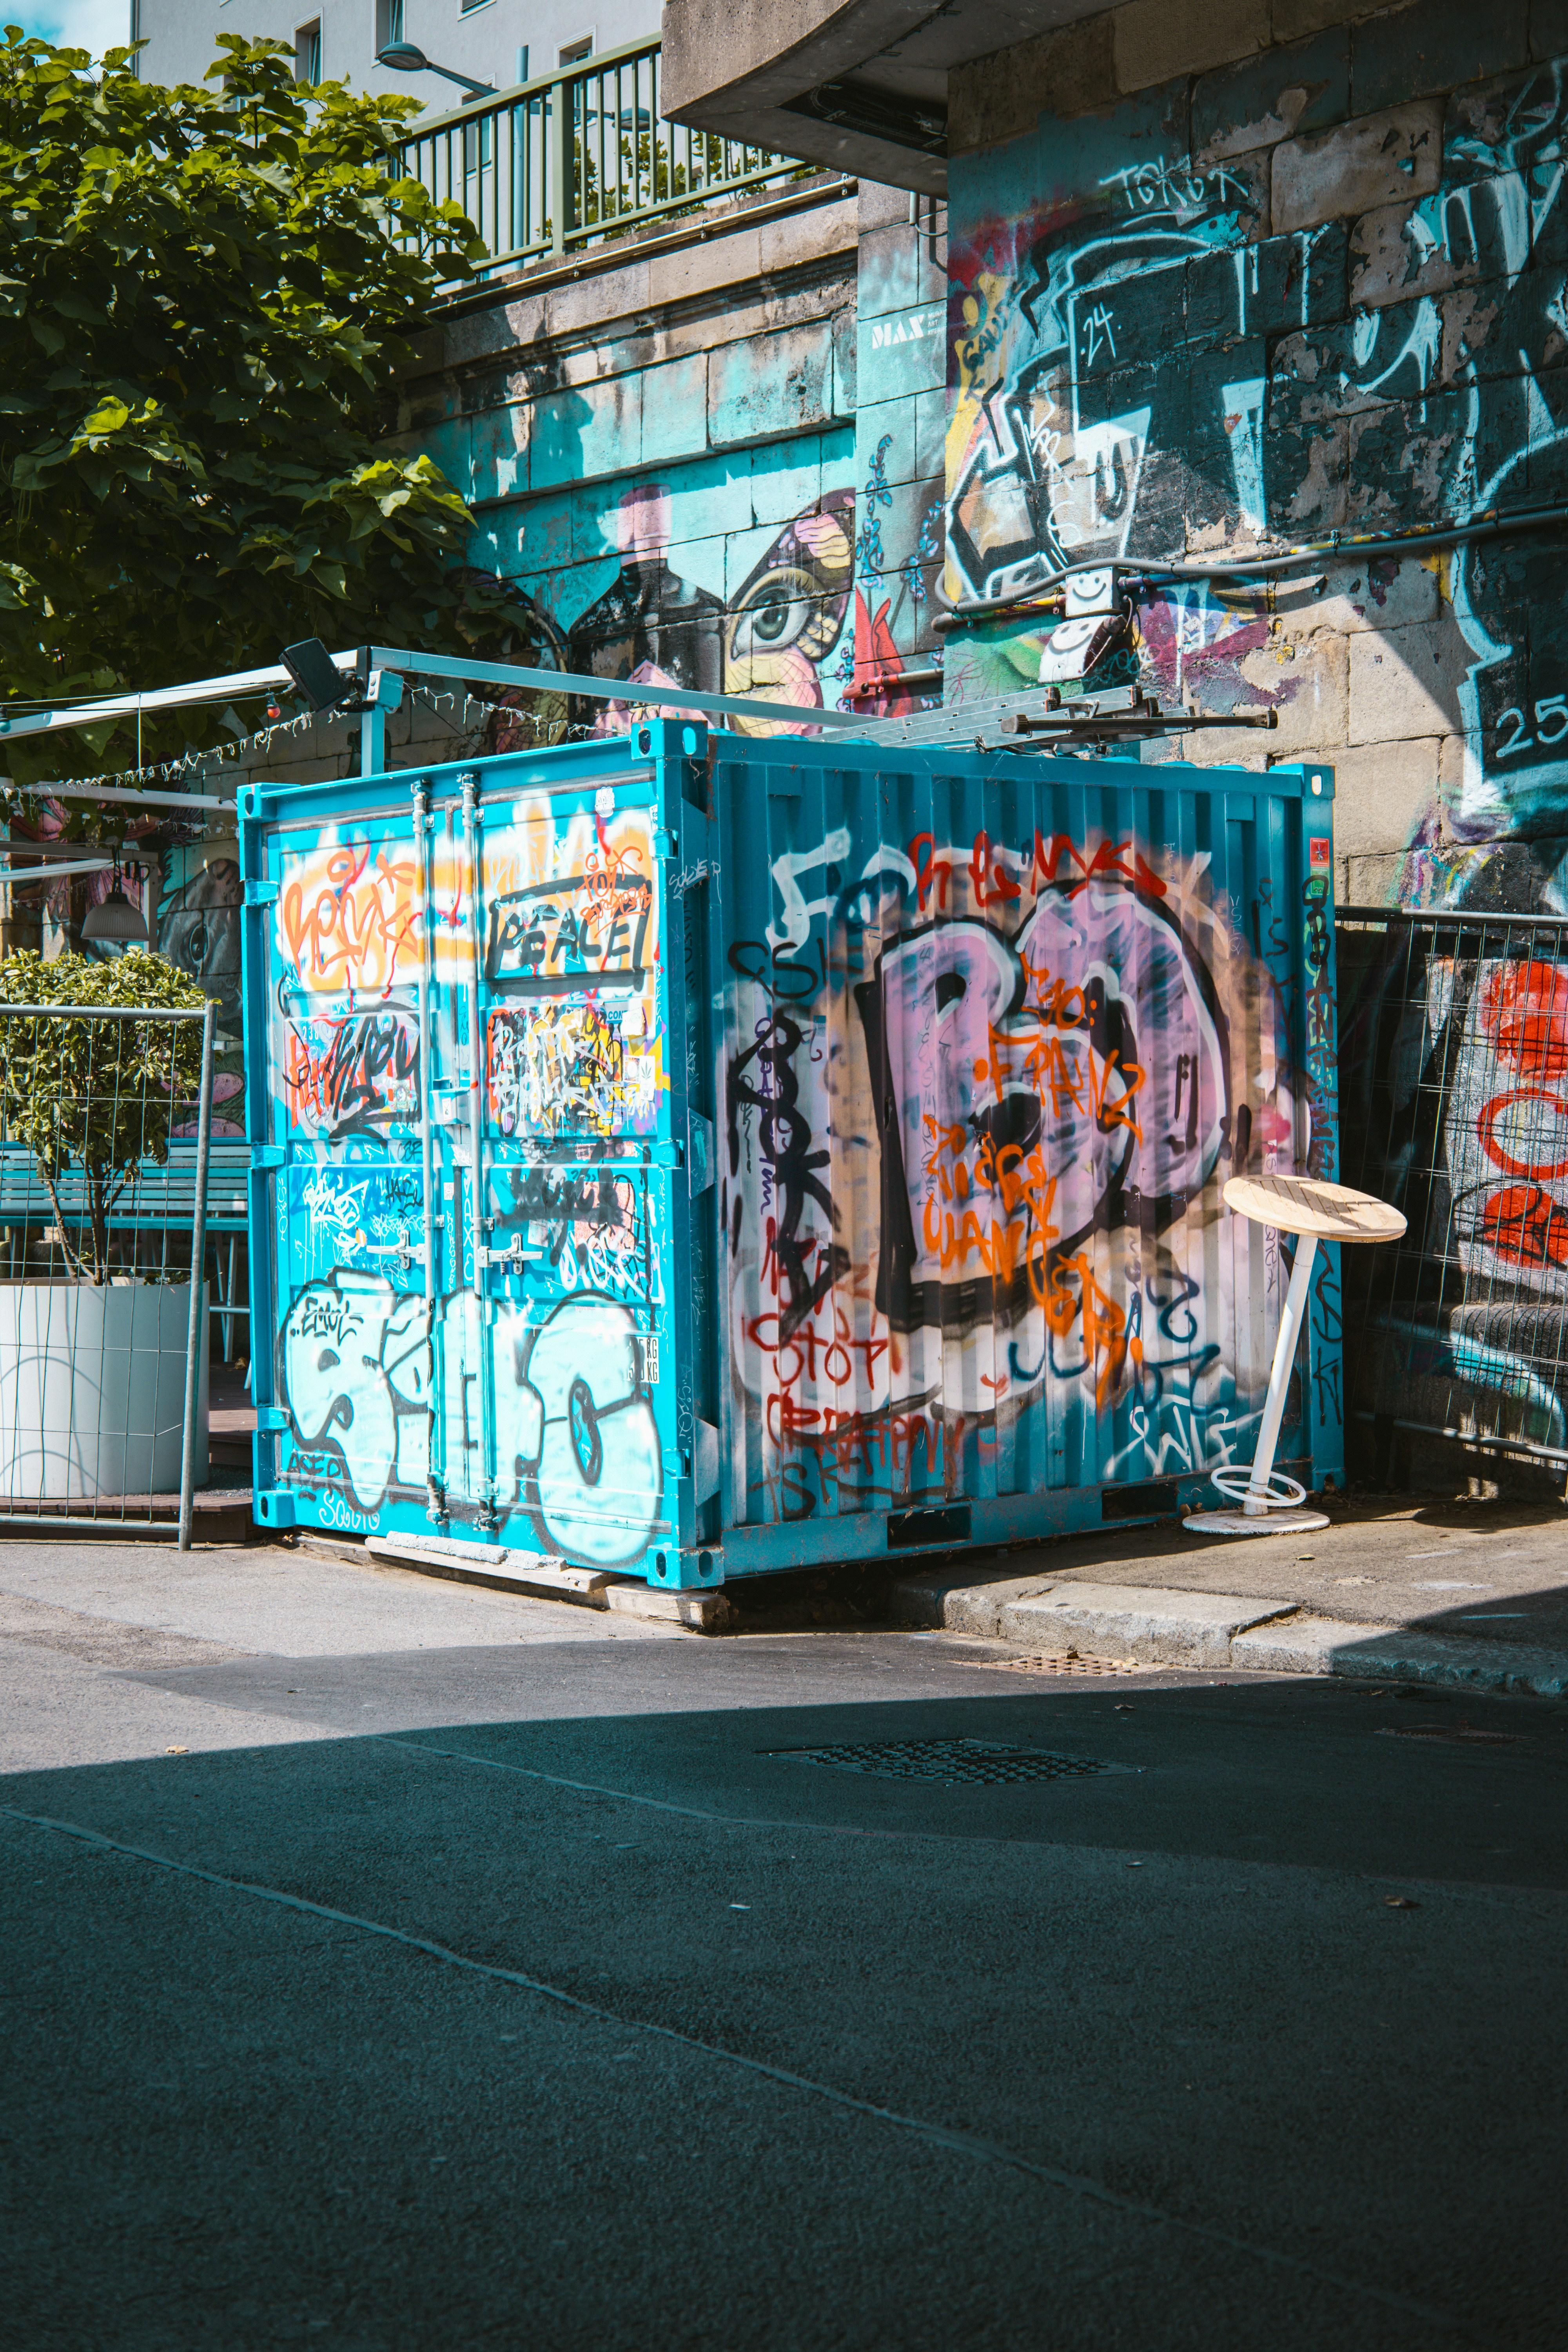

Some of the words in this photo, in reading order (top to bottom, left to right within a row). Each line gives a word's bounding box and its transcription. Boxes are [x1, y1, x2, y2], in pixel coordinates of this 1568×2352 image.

[872, 314, 925, 349] MAX
[927, 319, 938, 327] ART
[1496, 693, 1568, 757] 25
[608, 1010, 628, 1020] CON
